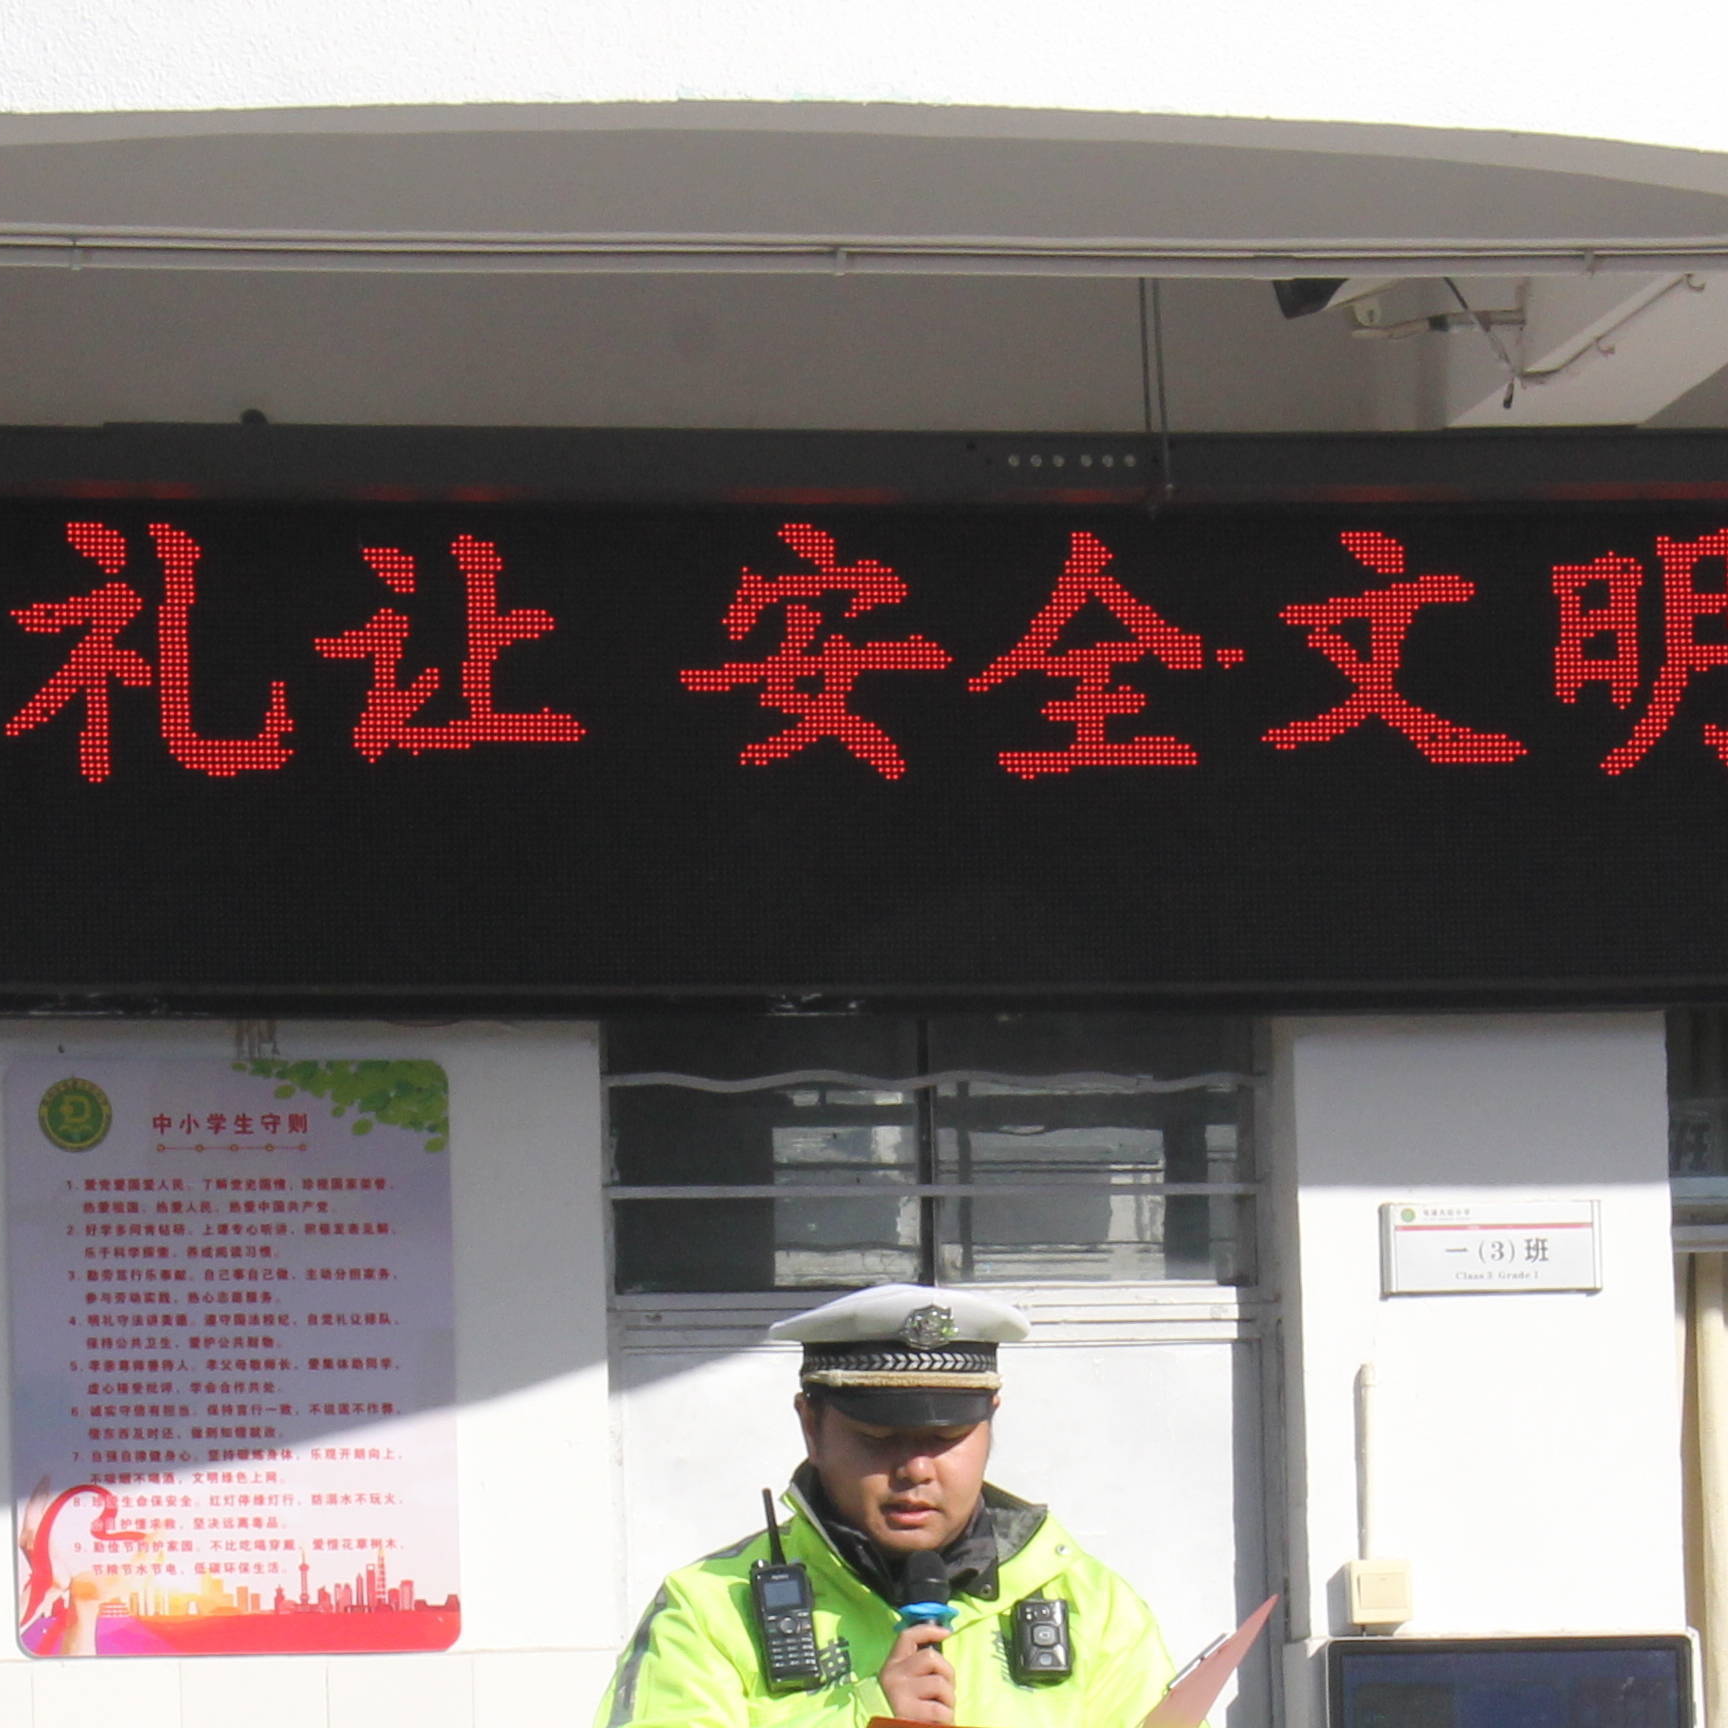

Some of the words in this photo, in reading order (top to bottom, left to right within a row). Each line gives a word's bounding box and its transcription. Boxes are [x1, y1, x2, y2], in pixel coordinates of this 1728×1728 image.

[152, 1111, 309, 1135] 中小学生守则
[1498, 1271, 1530, 1280] Grade
